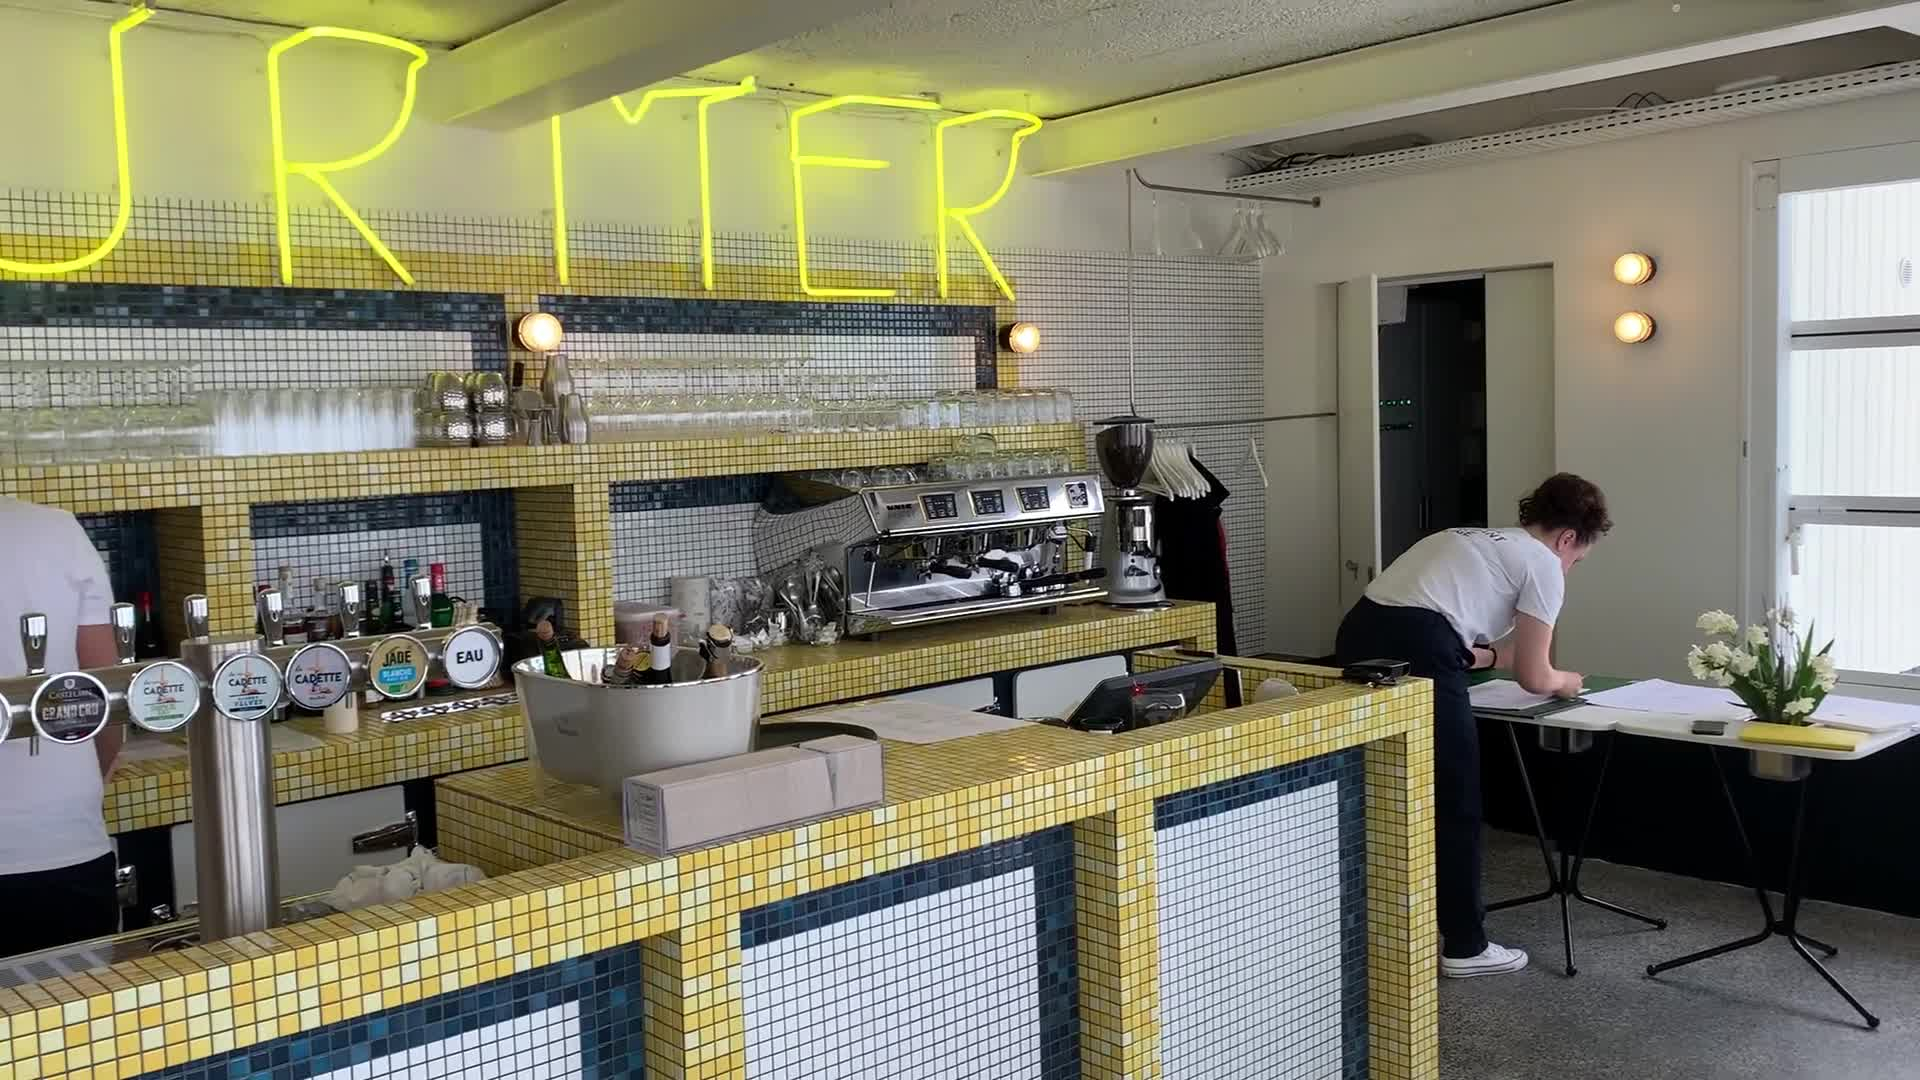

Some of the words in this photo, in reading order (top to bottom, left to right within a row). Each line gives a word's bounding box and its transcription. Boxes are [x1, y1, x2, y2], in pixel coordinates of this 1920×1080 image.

[382, 650, 412, 668] JADE
[456, 648, 483, 665] EAU
[228, 675, 268, 687] CADETTE
[294, 671, 343, 685] CADETTE
[143, 683, 185, 696] CADETTE
[42, 703, 78, 721] GRAND
[79, 702, 99, 718] CRU
